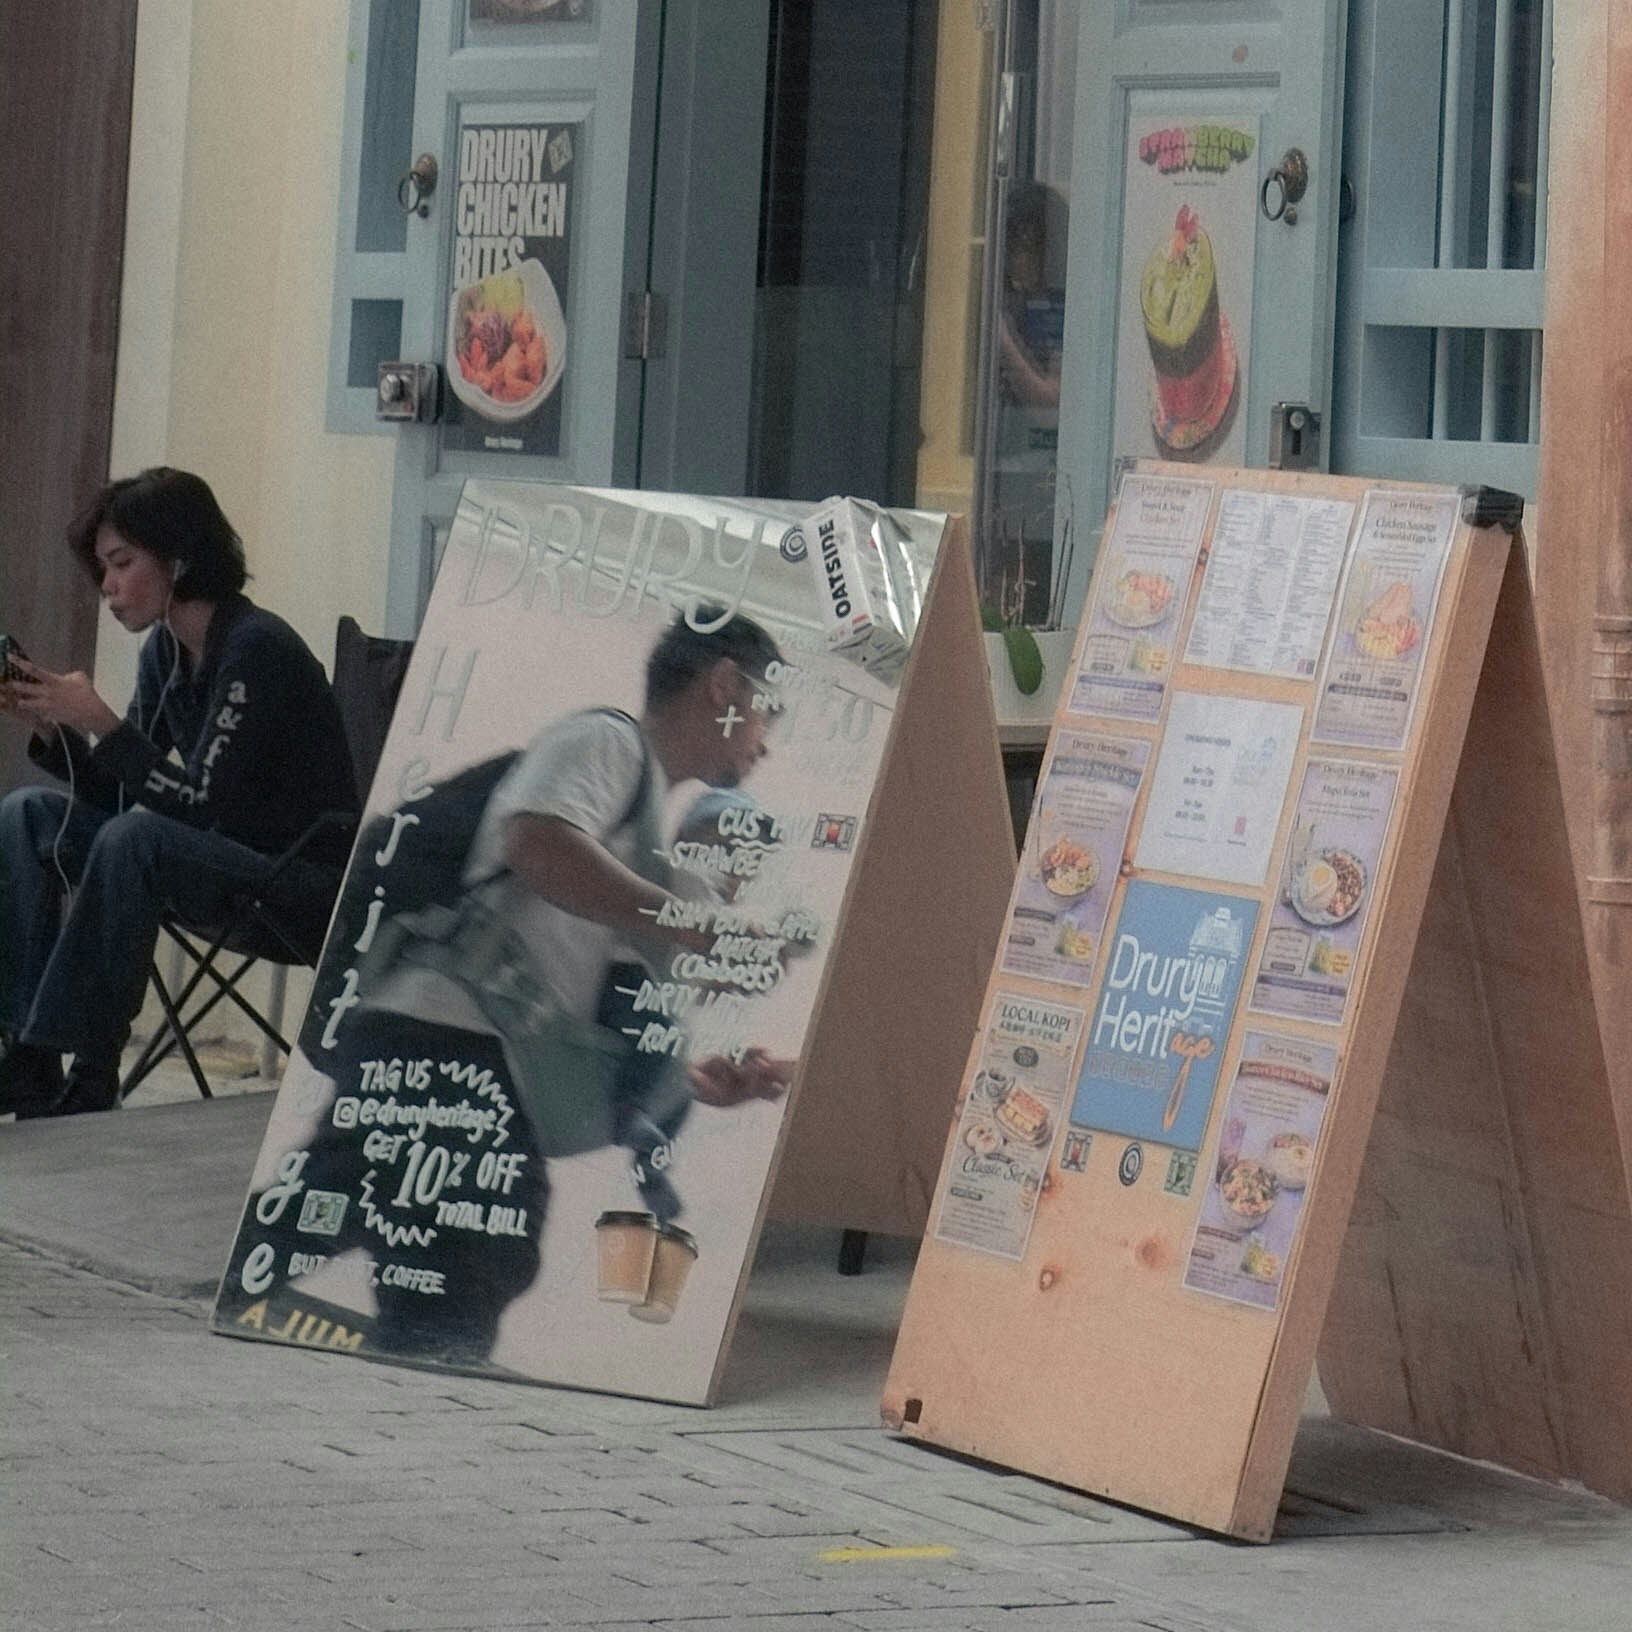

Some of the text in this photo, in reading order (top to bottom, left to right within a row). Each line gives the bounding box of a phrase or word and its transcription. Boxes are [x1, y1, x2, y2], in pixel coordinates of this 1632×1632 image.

[460, 128, 548, 182] DRURY
[456, 182, 567, 237] CHICKEN
[458, 502, 768, 635] DRURY
[818, 519, 851, 619] OATSIDE
[1108, 933, 1203, 1021] Drury
[1001, 1004, 1072, 1033] LOCAL KOPI
[359, 1058, 434, 1093] TAG US
[1094, 991, 1216, 1133] Heritage
[362, 1129, 407, 1164] GET
[476, 1151, 529, 1195] OFF
[435, 1200, 529, 1237] TOTAL BILL
[381, 1263, 447, 1296] COFFEE
